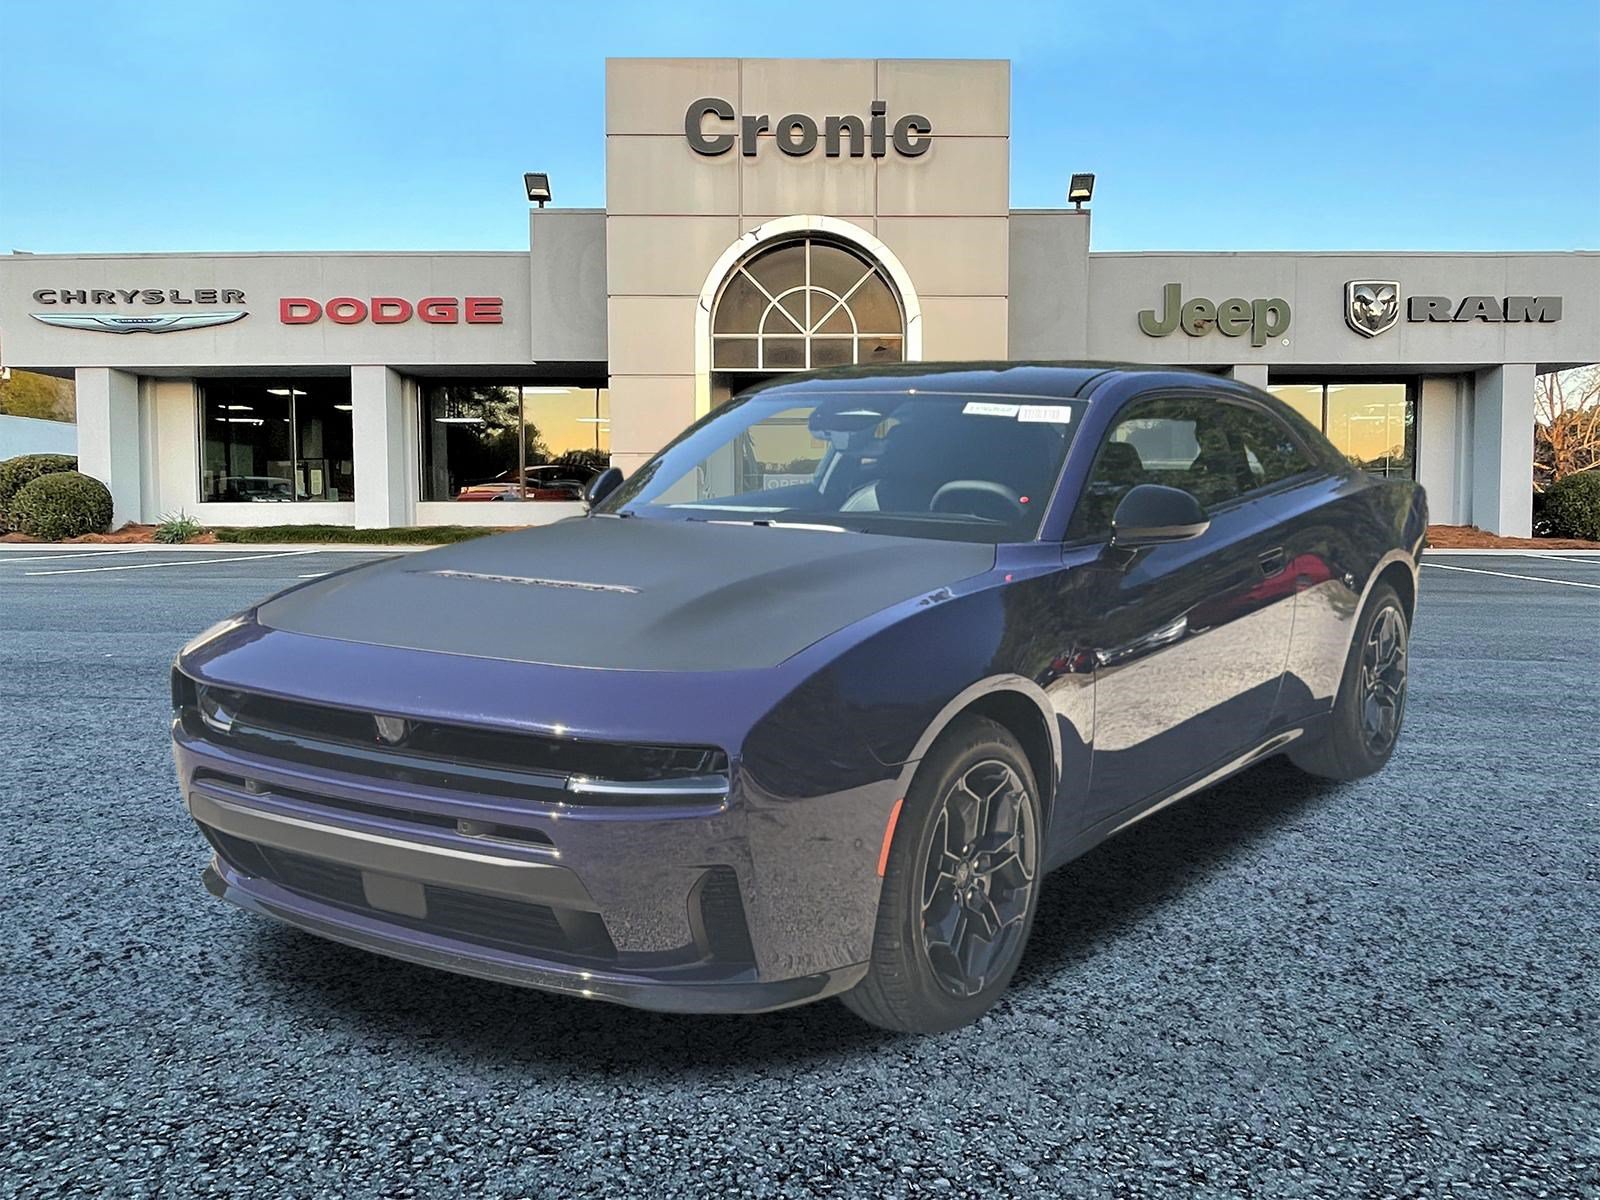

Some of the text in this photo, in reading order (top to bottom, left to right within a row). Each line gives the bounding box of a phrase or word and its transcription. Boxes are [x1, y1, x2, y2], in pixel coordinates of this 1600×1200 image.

[685, 97, 932, 157] Cronic
[32, 289, 246, 304] CHRYSLER
[1407, 296, 1563, 322] RAM
[279, 297, 503, 325] DODGE
[1138, 283, 1291, 347] Jeep
